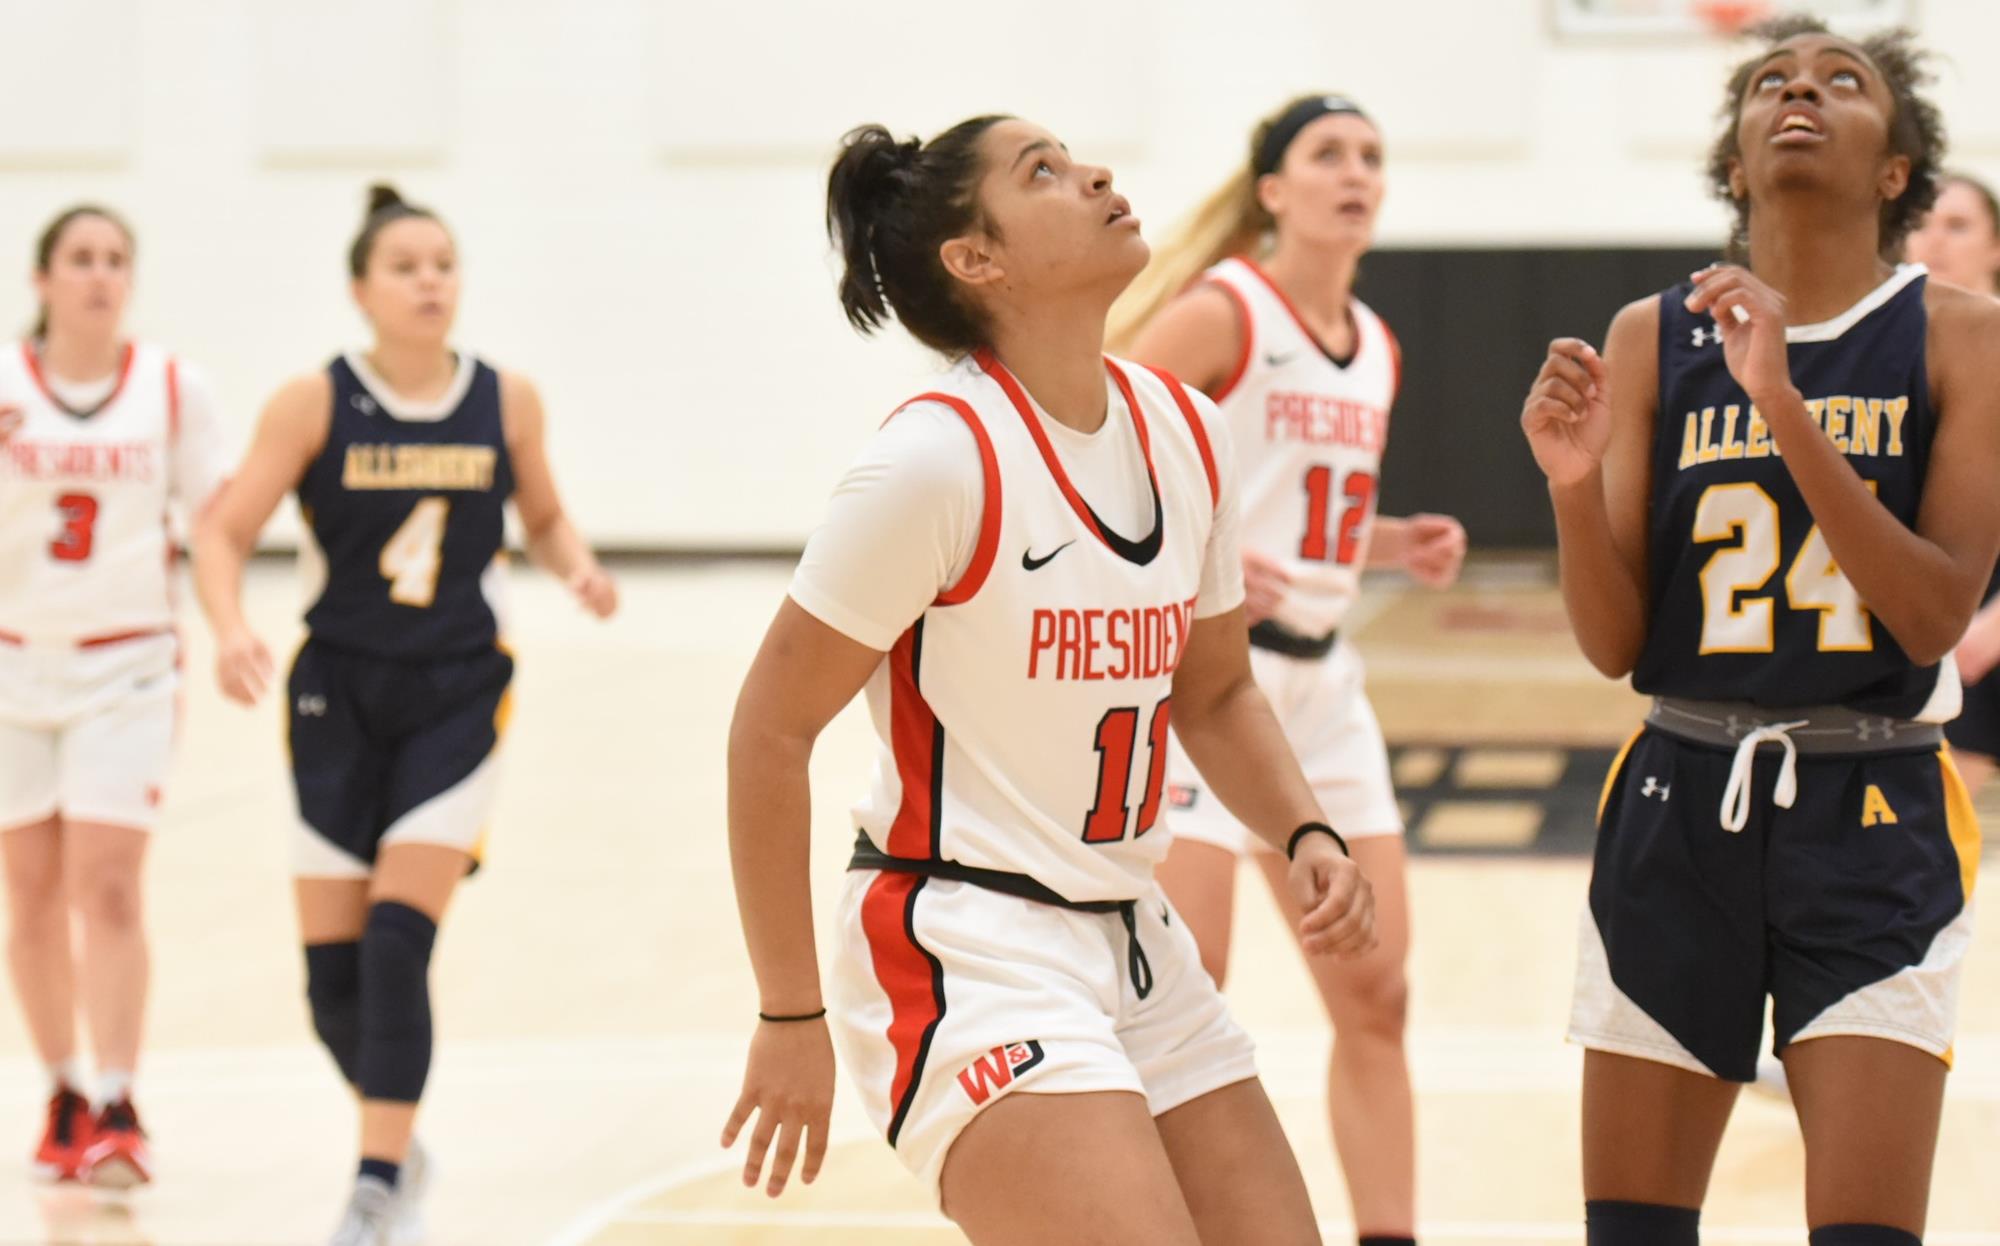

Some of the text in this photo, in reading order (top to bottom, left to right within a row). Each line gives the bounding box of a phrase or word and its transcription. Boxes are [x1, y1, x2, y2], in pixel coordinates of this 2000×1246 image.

[1678, 395, 1909, 470] ALLEENY
[50, 493, 98, 562] 3
[379, 495, 450, 608] 4
[1299, 464, 1377, 566] 12
[1692, 480, 1878, 655] 24
[1081, 694, 1171, 845] 11
[1861, 784, 1898, 829] A
